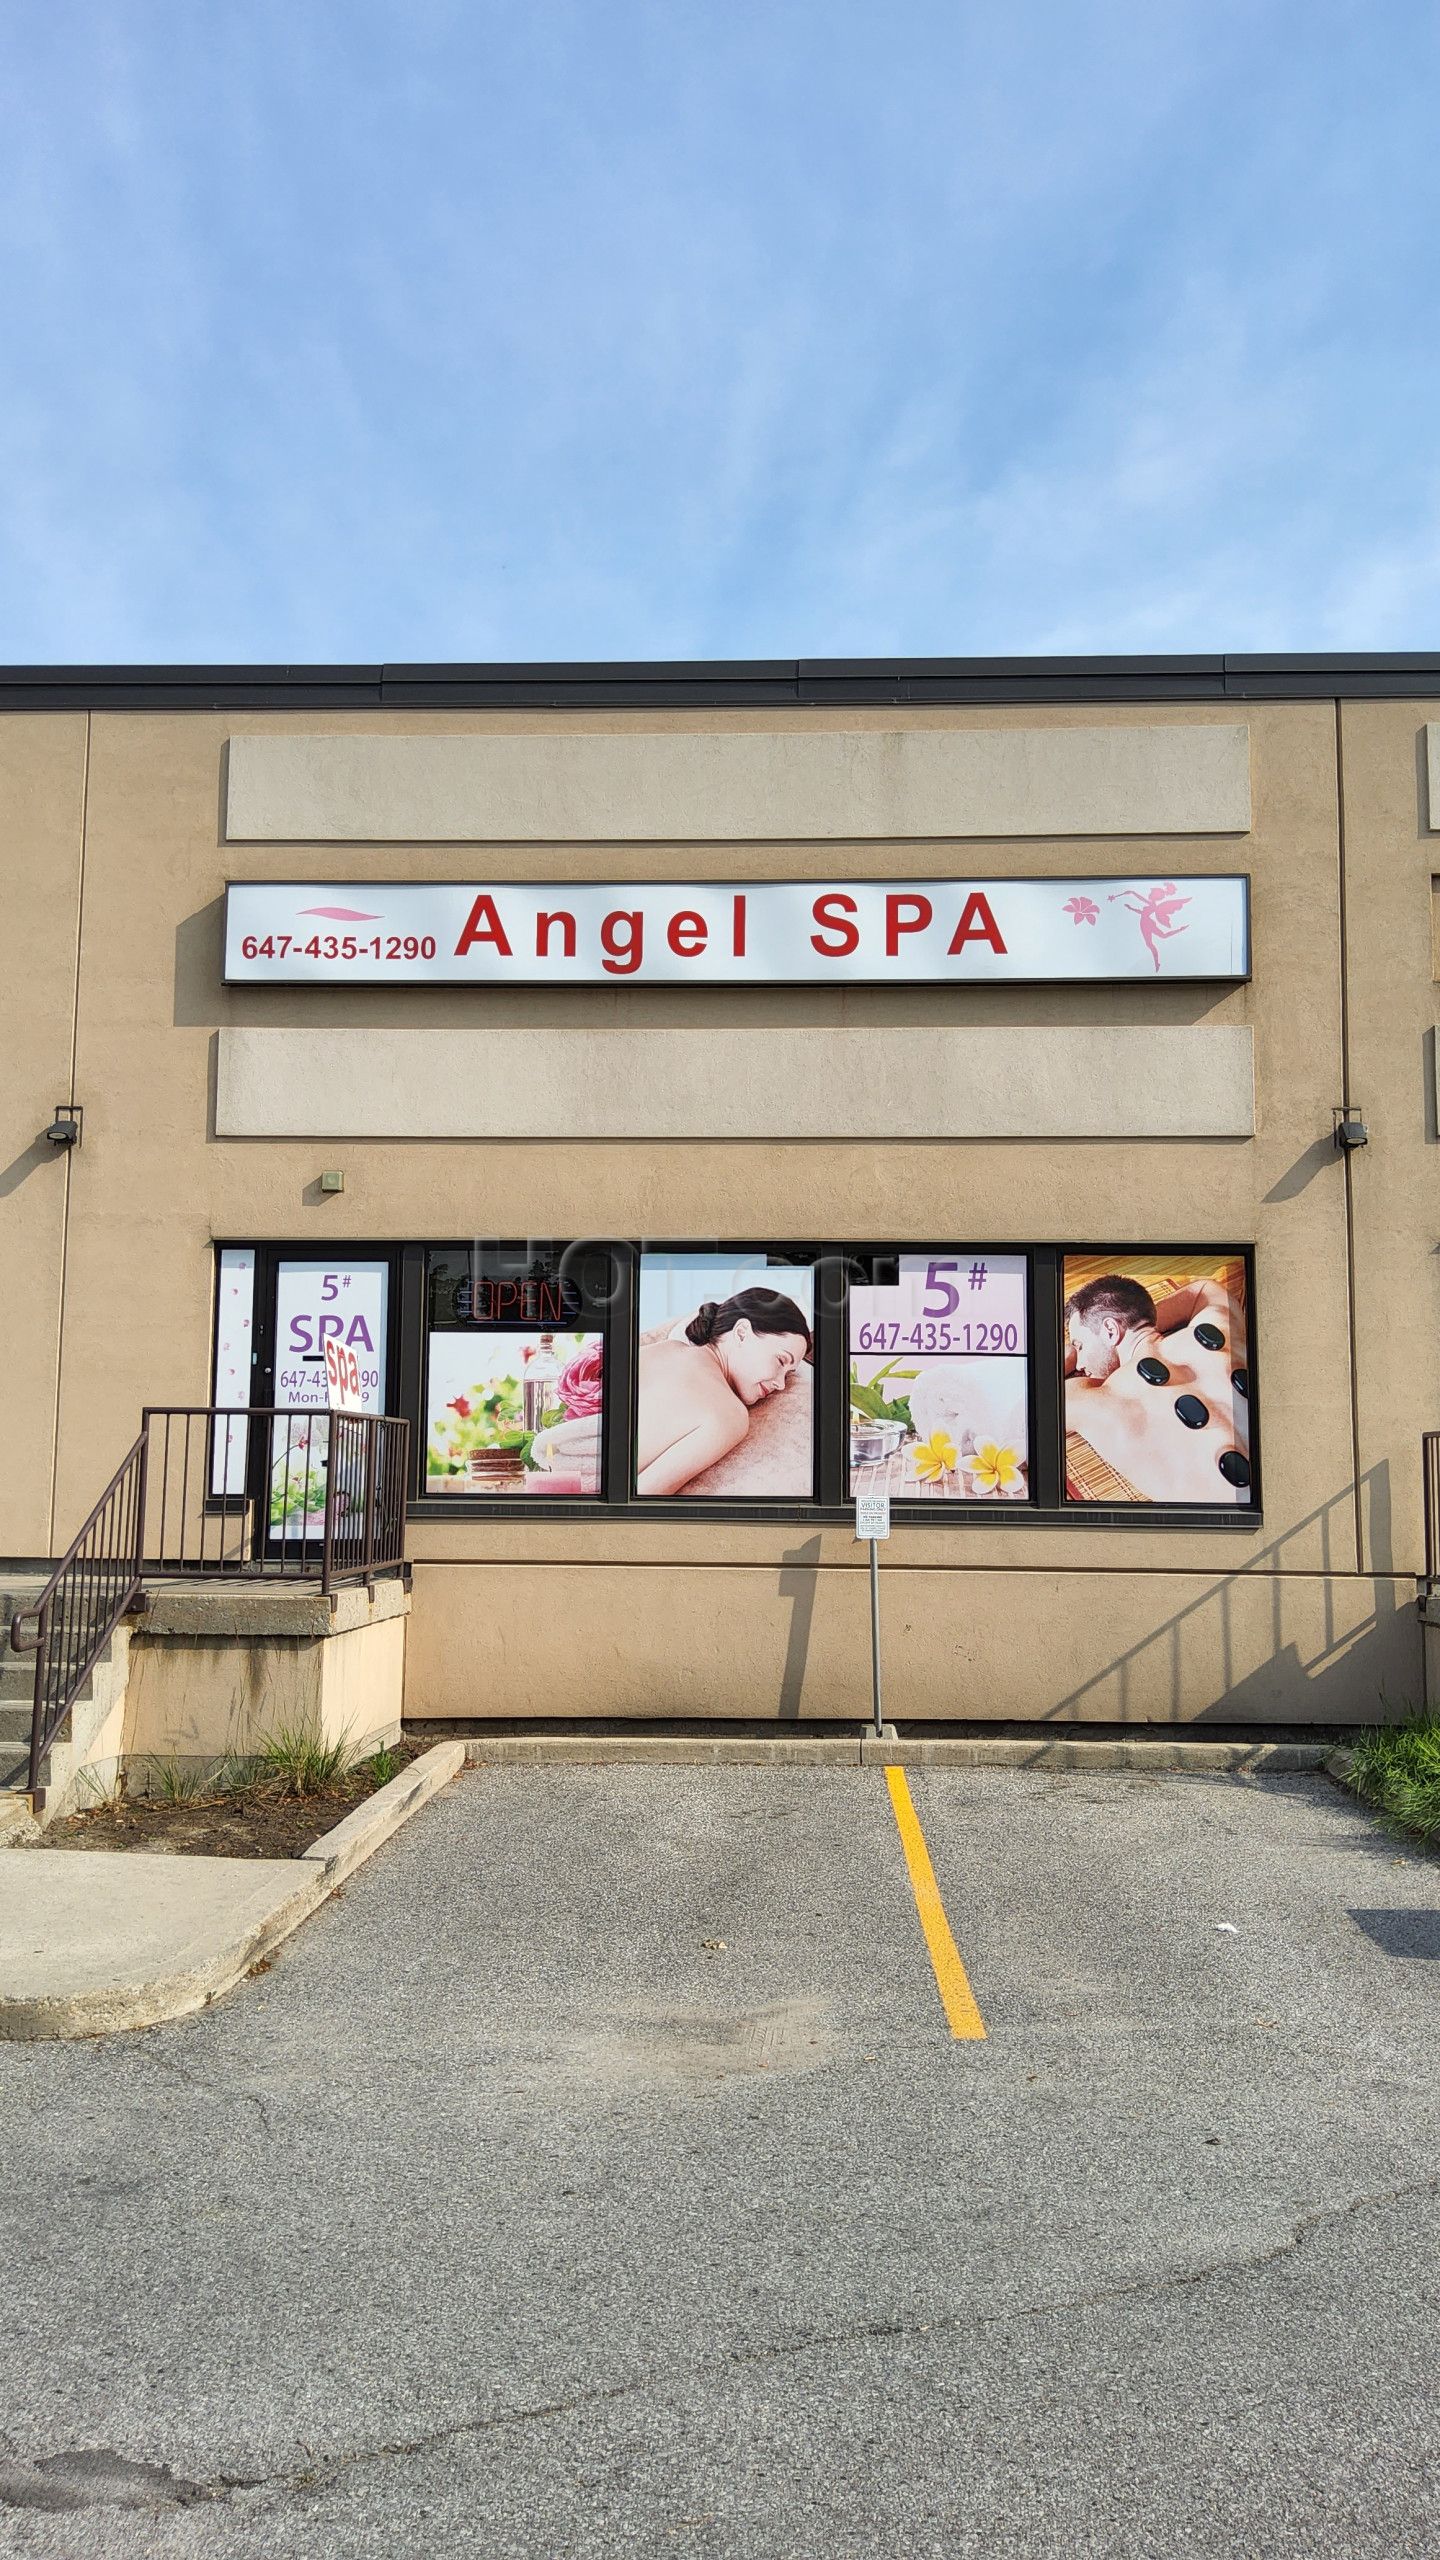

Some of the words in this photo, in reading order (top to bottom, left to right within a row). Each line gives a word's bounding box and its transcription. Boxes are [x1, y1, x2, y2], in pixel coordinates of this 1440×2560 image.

[241, 935, 436, 960] 647-435-1290
[453, 895, 746, 975] Angel
[810, 892, 1008, 957] SPA
[472, 1281, 562, 1320] OPEN
[289, 1314, 375, 1353] SPA
[859, 1323, 1018, 1351] 647-435-1290
[280, 1370, 379, 1388] 647-4390
[326, 1340, 360, 1405] spa
